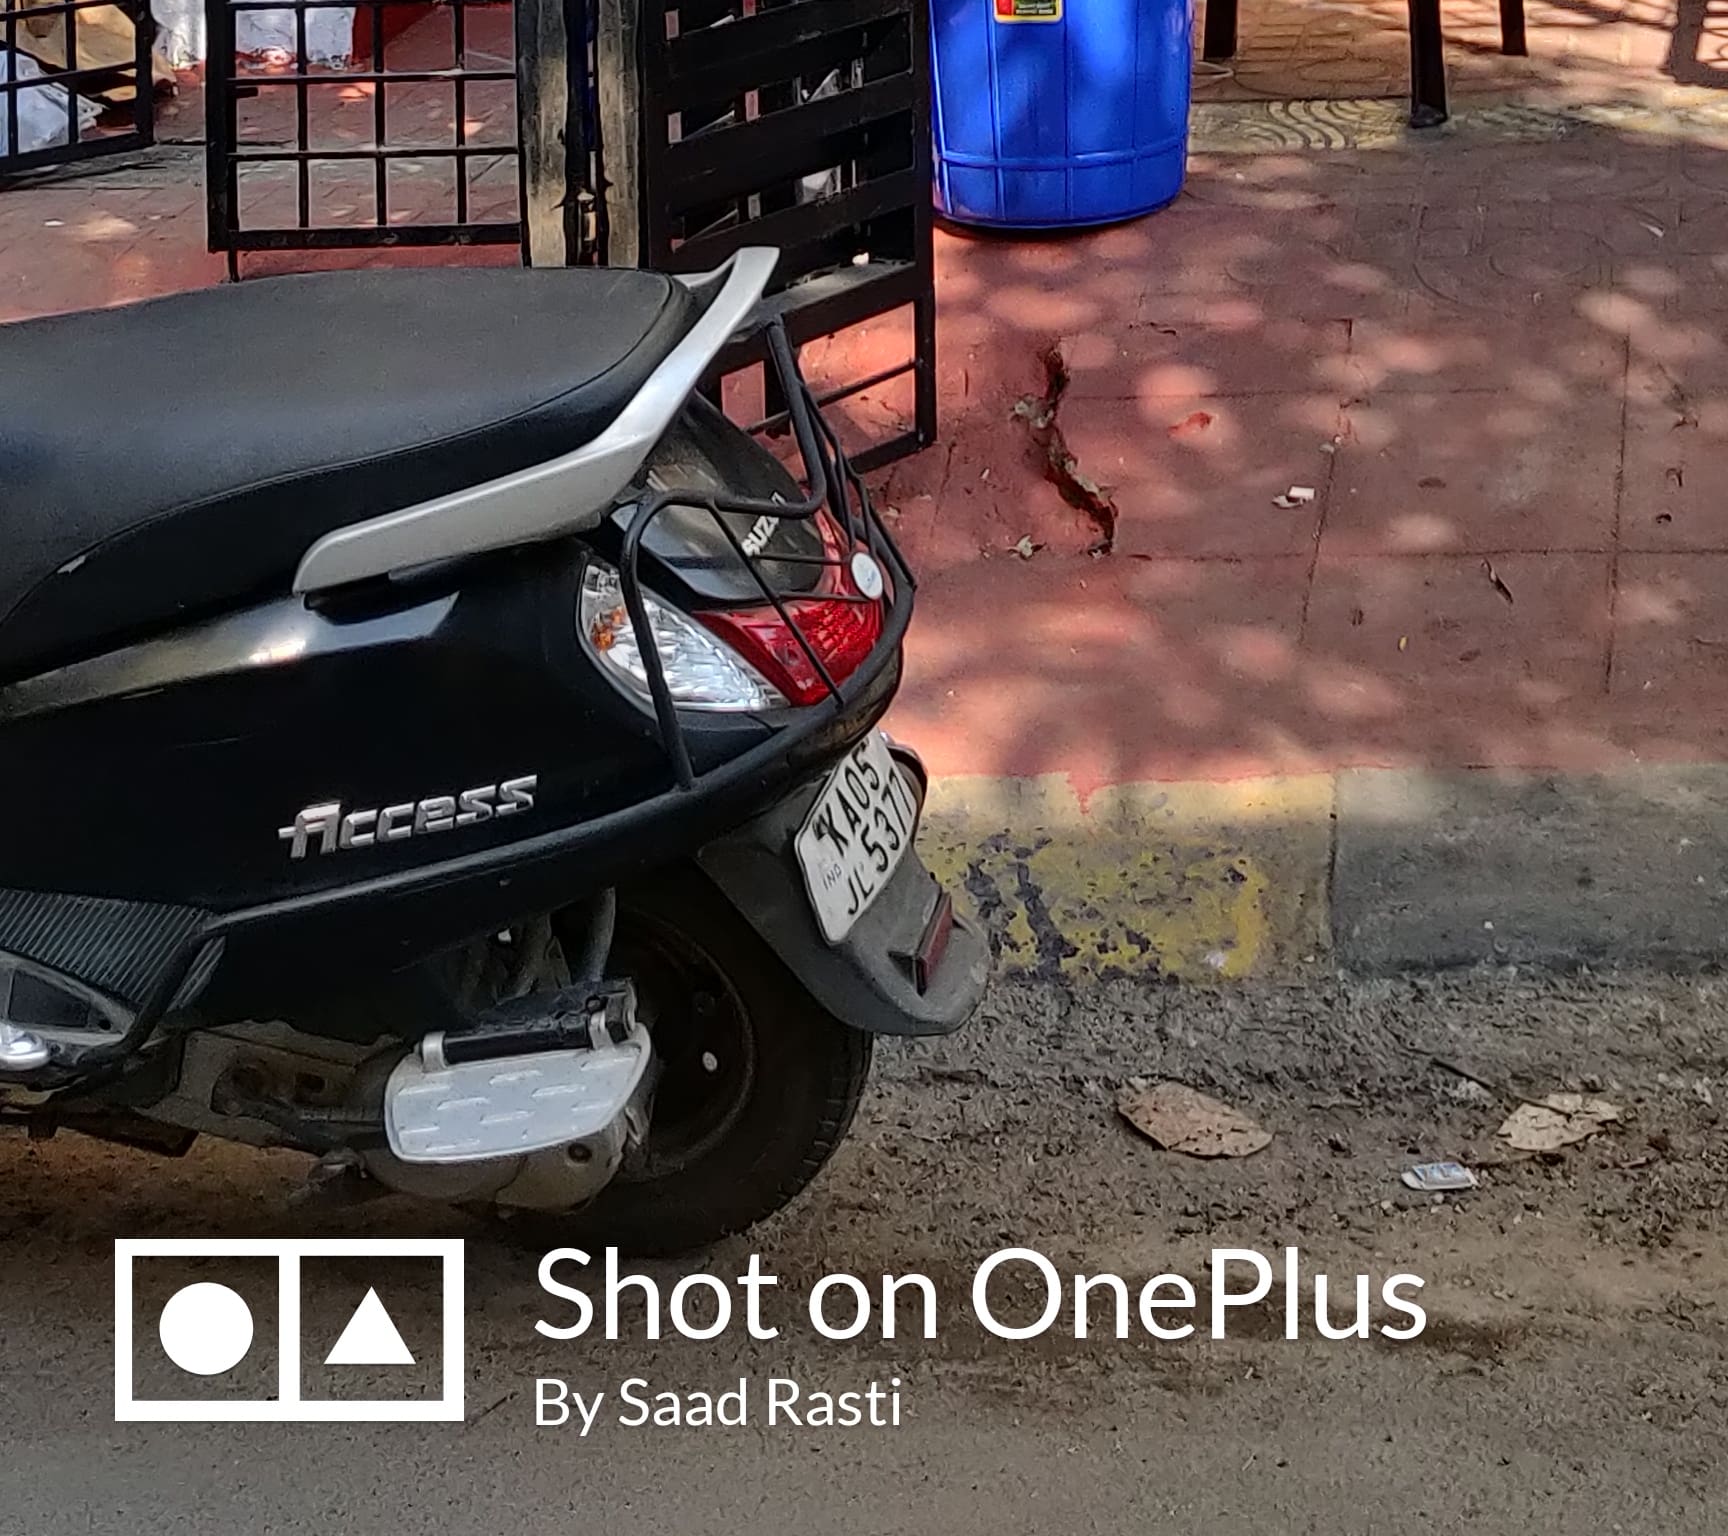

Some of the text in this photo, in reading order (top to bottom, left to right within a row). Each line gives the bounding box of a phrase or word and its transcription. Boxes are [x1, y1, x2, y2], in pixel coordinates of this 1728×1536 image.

[822, 739, 880, 860] KA05
[848, 766, 914, 915] JL 5377
[822, 863, 843, 891] IND
